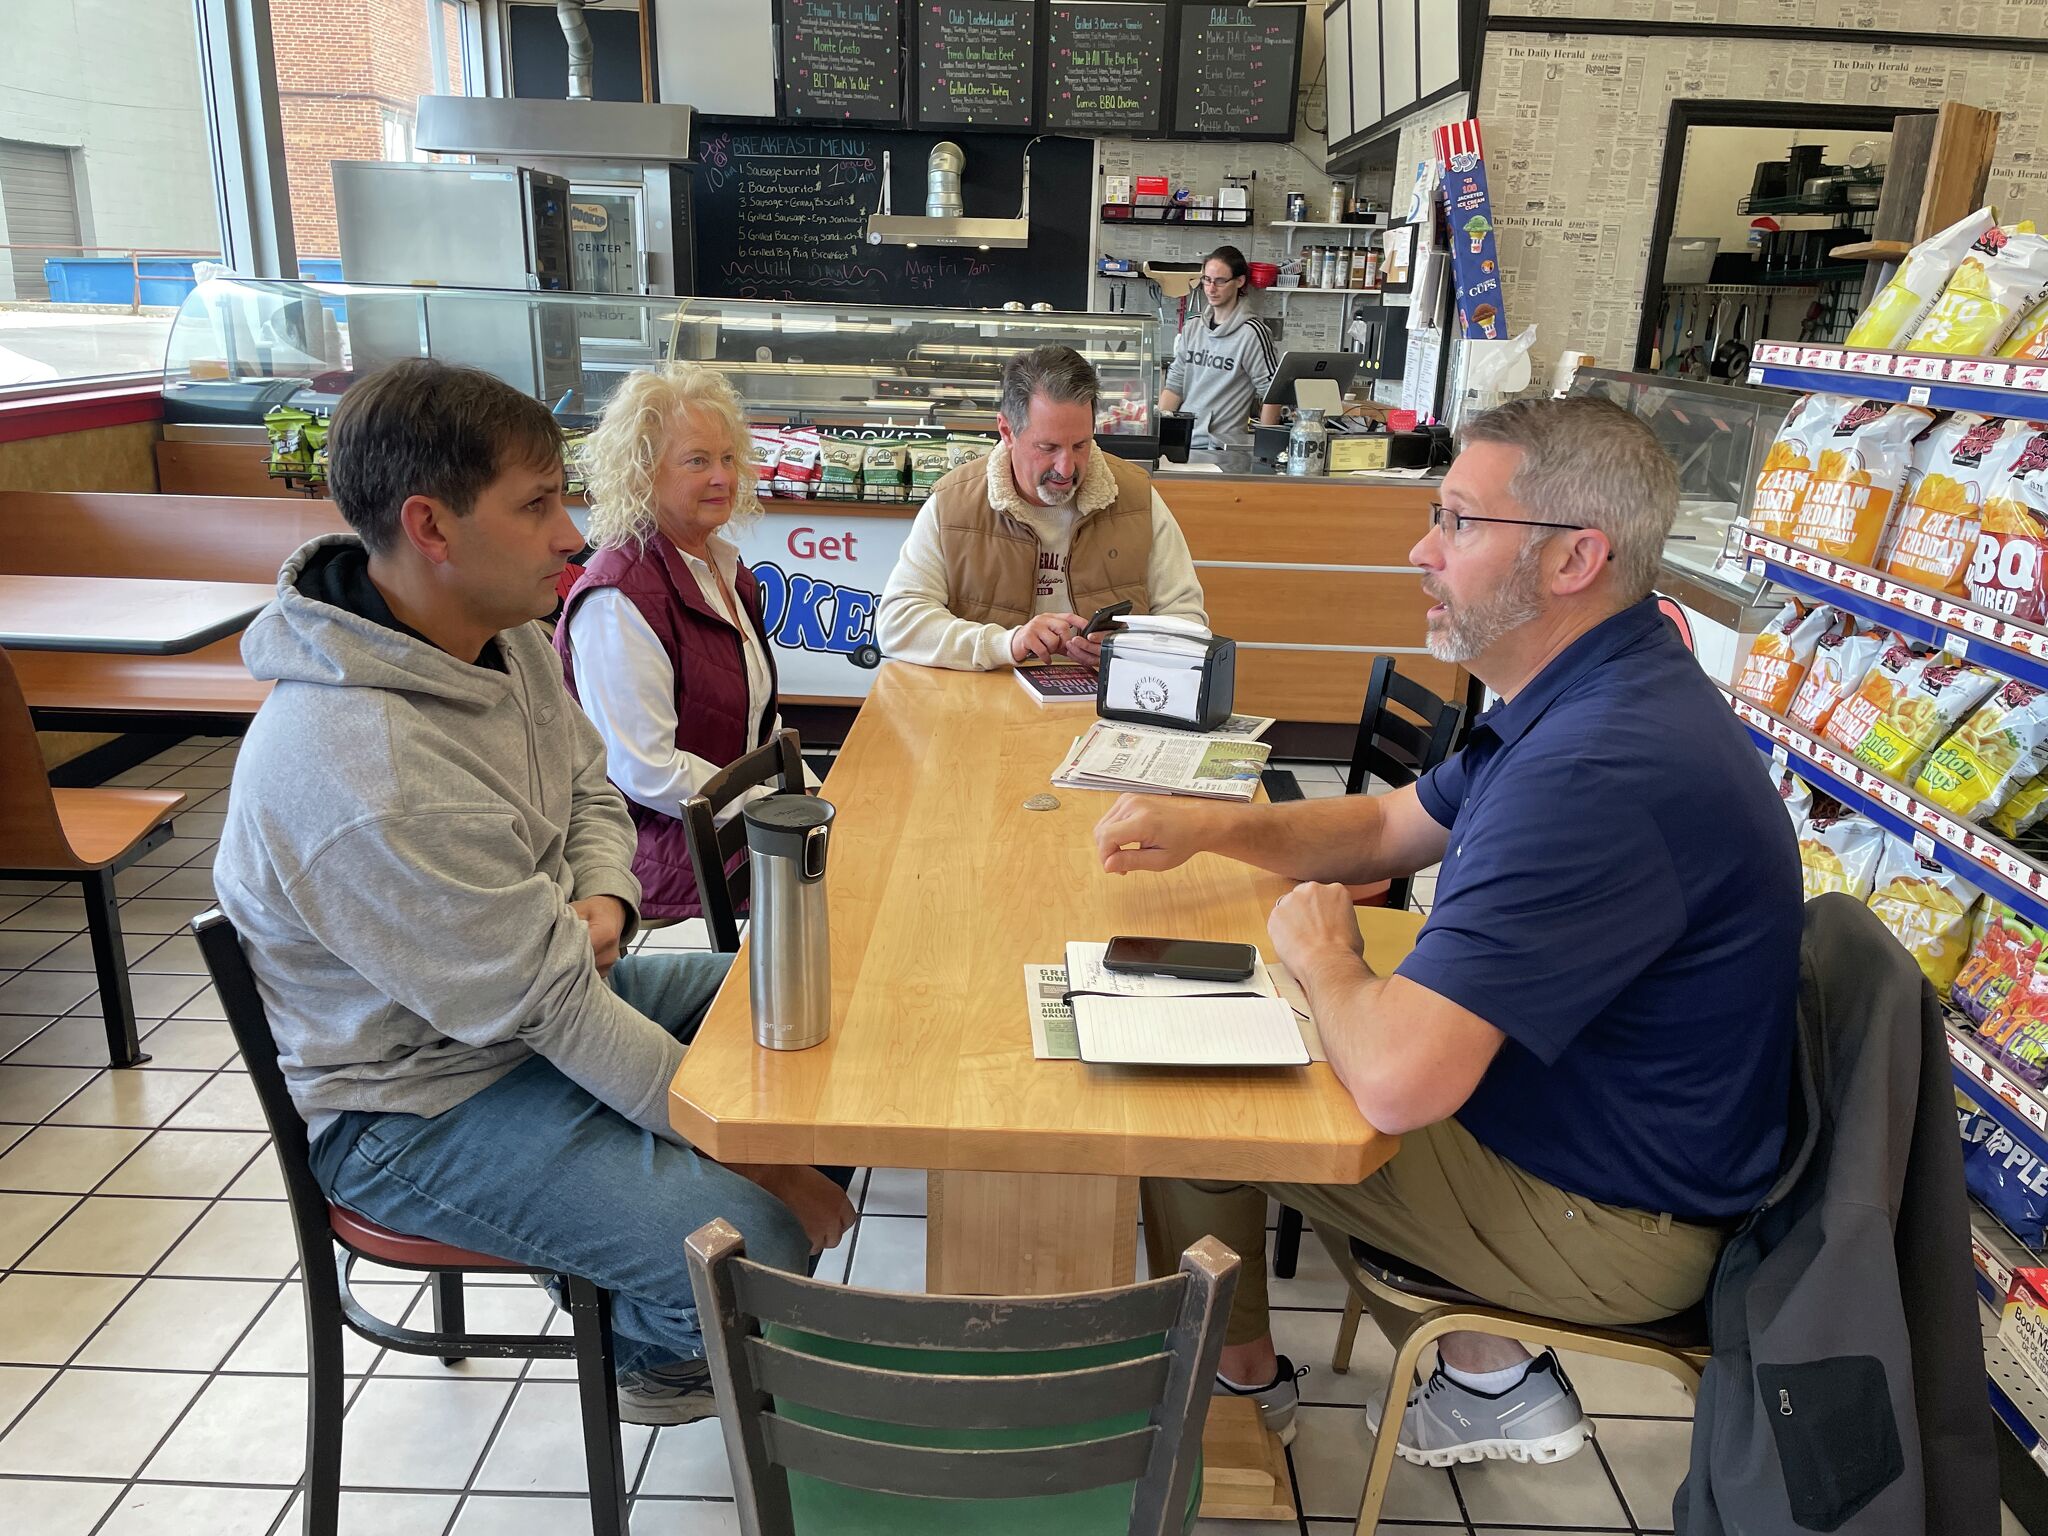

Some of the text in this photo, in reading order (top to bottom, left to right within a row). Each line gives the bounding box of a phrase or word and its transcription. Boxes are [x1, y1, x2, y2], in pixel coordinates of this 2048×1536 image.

[948, 9, 965, 24] Club
[1094, 17, 1099, 30] 3
[1100, 18, 1118, 30] Cheese
[813, 36, 861, 55] Monte Cristo
[1508, 47, 1586, 59] The Daily Herald
[1226, 67, 1245, 79] Cheese
[1833, 60, 1909, 72] The Daily Herald
[813, 72, 829, 88] BLT
[967, 82, 986, 95] Cheese
[990, 82, 1010, 102] Turkey
[1099, 94, 1116, 109] BBQ
[1117, 95, 1140, 109] Chicken
[732, 136, 817, 156] BREAKFAST
[746, 162, 782, 182] Sausage
[783, 164, 815, 177] burrito
[1992, 168, 2048, 180] Daily Herald
[738, 182, 815, 194] 2 Bacon burrito
[738, 196, 747, 207] 3
[749, 198, 784, 211] Sausage
[814, 196, 850, 207] Biscuits
[1457, 191, 1485, 202] JACKETED
[1466, 197, 1485, 206] CREAM
[1465, 203, 1479, 211] CUPS
[738, 212, 746, 221] 4
[747, 212, 772, 222] Grilled
[774, 212, 807, 226] Sausage
[811, 213, 827, 226] Egg
[1492, 217, 1563, 227] he Daily Herald
[738, 226, 746, 240] 5
[747, 230, 773, 242] Grilled
[577, 243, 622, 253] CENTER
[738, 245, 747, 258] 6
[747, 247, 775, 257] Grilled
[793, 248, 809, 259] Rig
[810, 249, 850, 260] Breakfast
[910, 275, 934, 289] Sat
[1469, 281, 1497, 297] CUPS
[1812, 481, 1871, 509] CREAM
[1798, 503, 1857, 531] HEDDAR
[1922, 511, 1981, 543] CREAM
[787, 527, 859, 561] Get
[1902, 532, 1966, 565] CHEDDAR
[1039, 552, 1059, 570] ERAL
[1973, 533, 2036, 592] BQ
[750, 561, 884, 655] OKE
[1851, 696, 1881, 726] CREA
[1932, 748, 1977, 780] nion
[1920, 762, 1962, 792] ings
[1039, 968, 1068, 976] GRE
[2014, 1306, 2037, 1337] Book
[2015, 1324, 2031, 1345] CAJA
